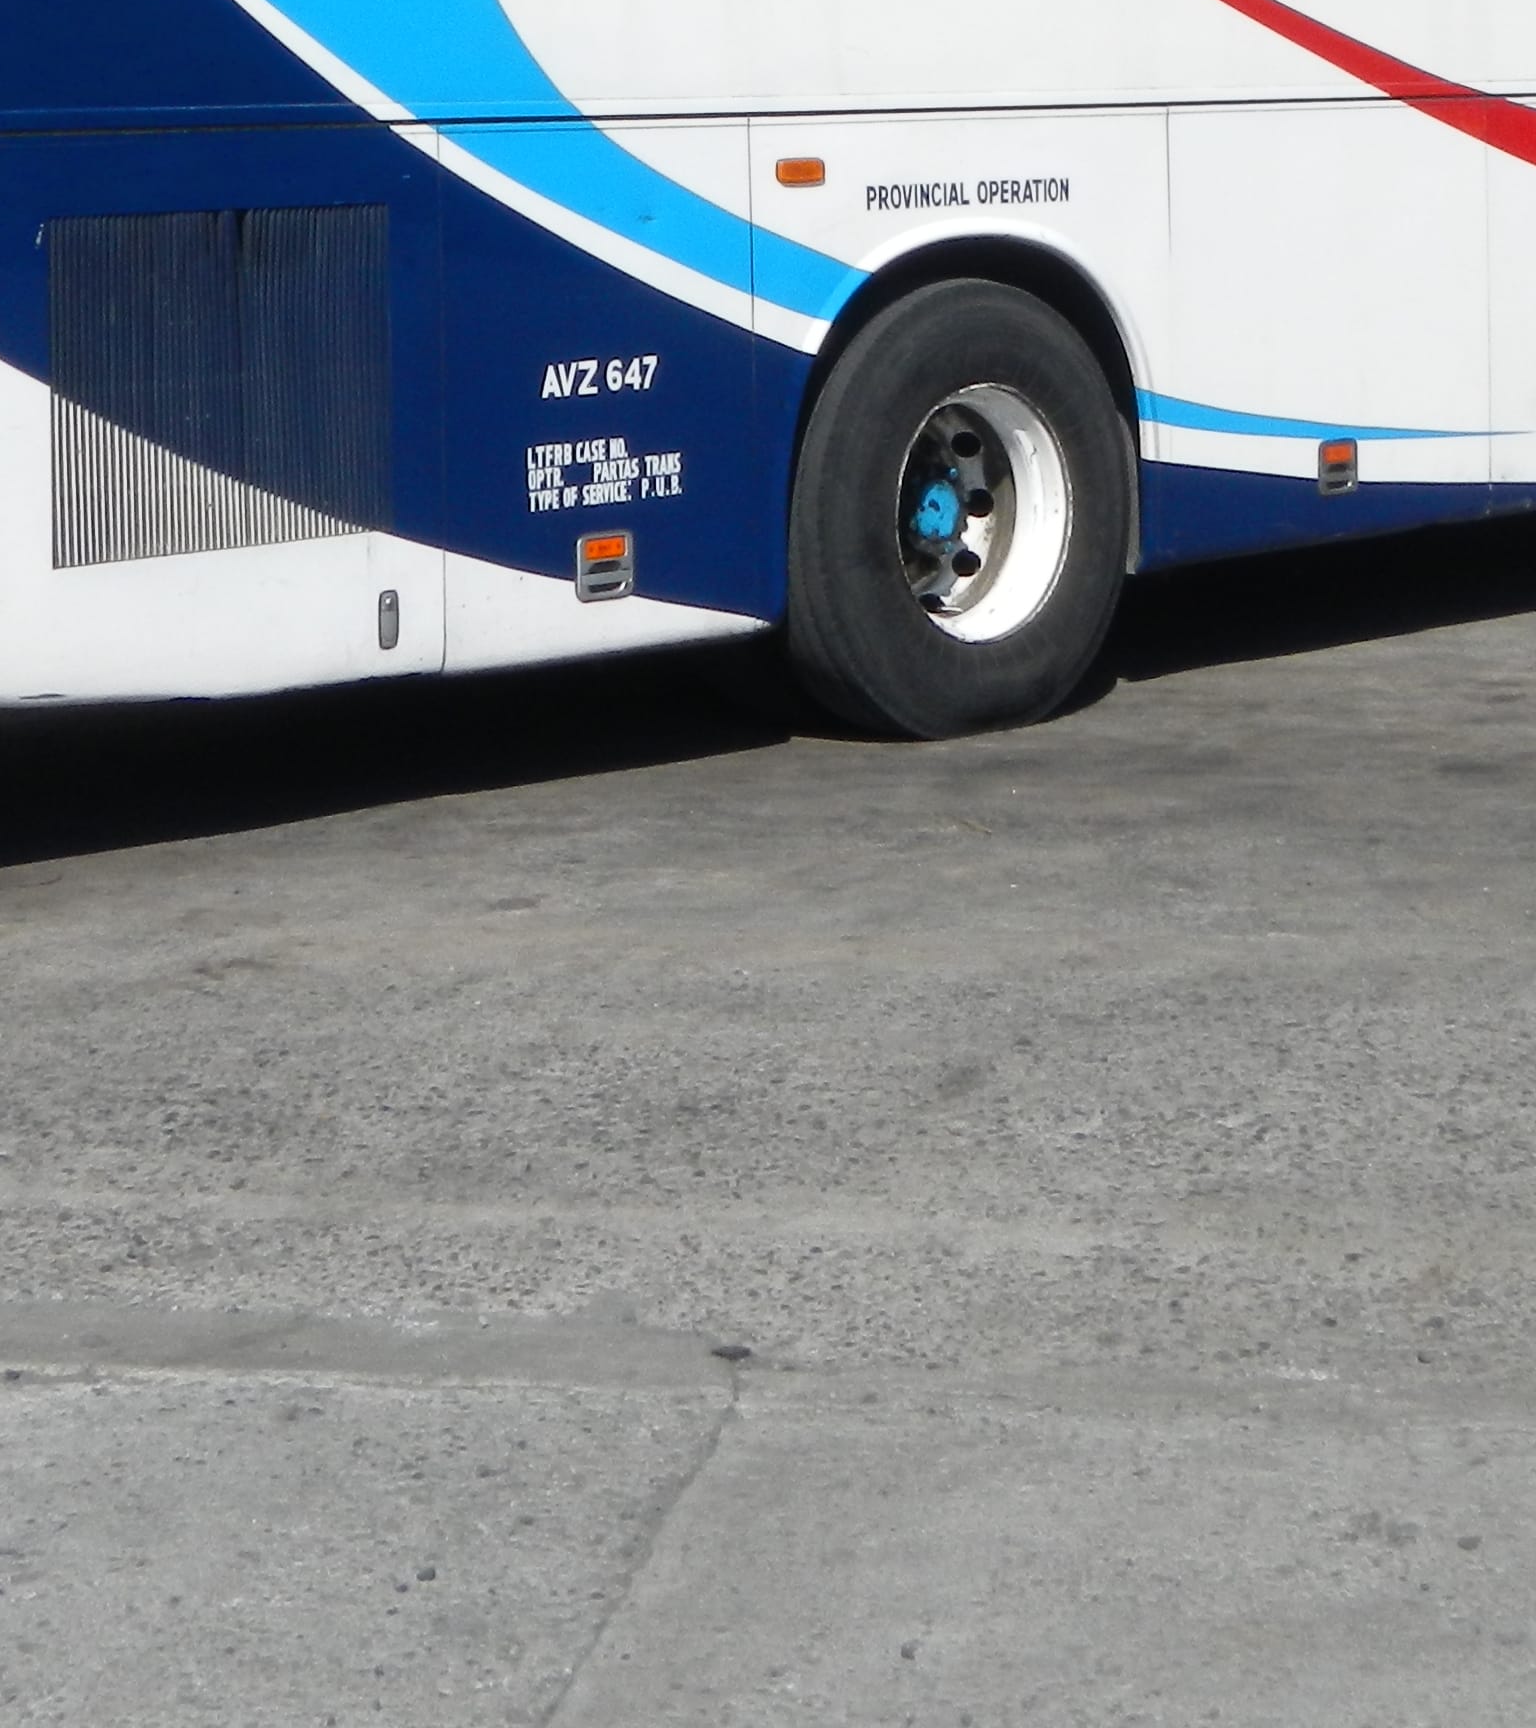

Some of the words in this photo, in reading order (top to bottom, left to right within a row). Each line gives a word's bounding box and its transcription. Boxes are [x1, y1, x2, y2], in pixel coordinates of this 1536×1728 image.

[866, 182, 970, 211] PROVINCIAL
[977, 178, 1070, 204] OPERATION
[541, 359, 599, 399] AVZ
[605, 354, 659, 392] 647
[527, 443, 573, 470] LTFRB
[576, 439, 606, 464] CASE
[609, 437, 629, 459] NO.
[527, 467, 564, 490] OPTR.
[593, 458, 640, 483] PARTAS
[644, 452, 682, 477] TRANS
[529, 488, 560, 512] TYPE
[563, 486, 578, 508] OF
